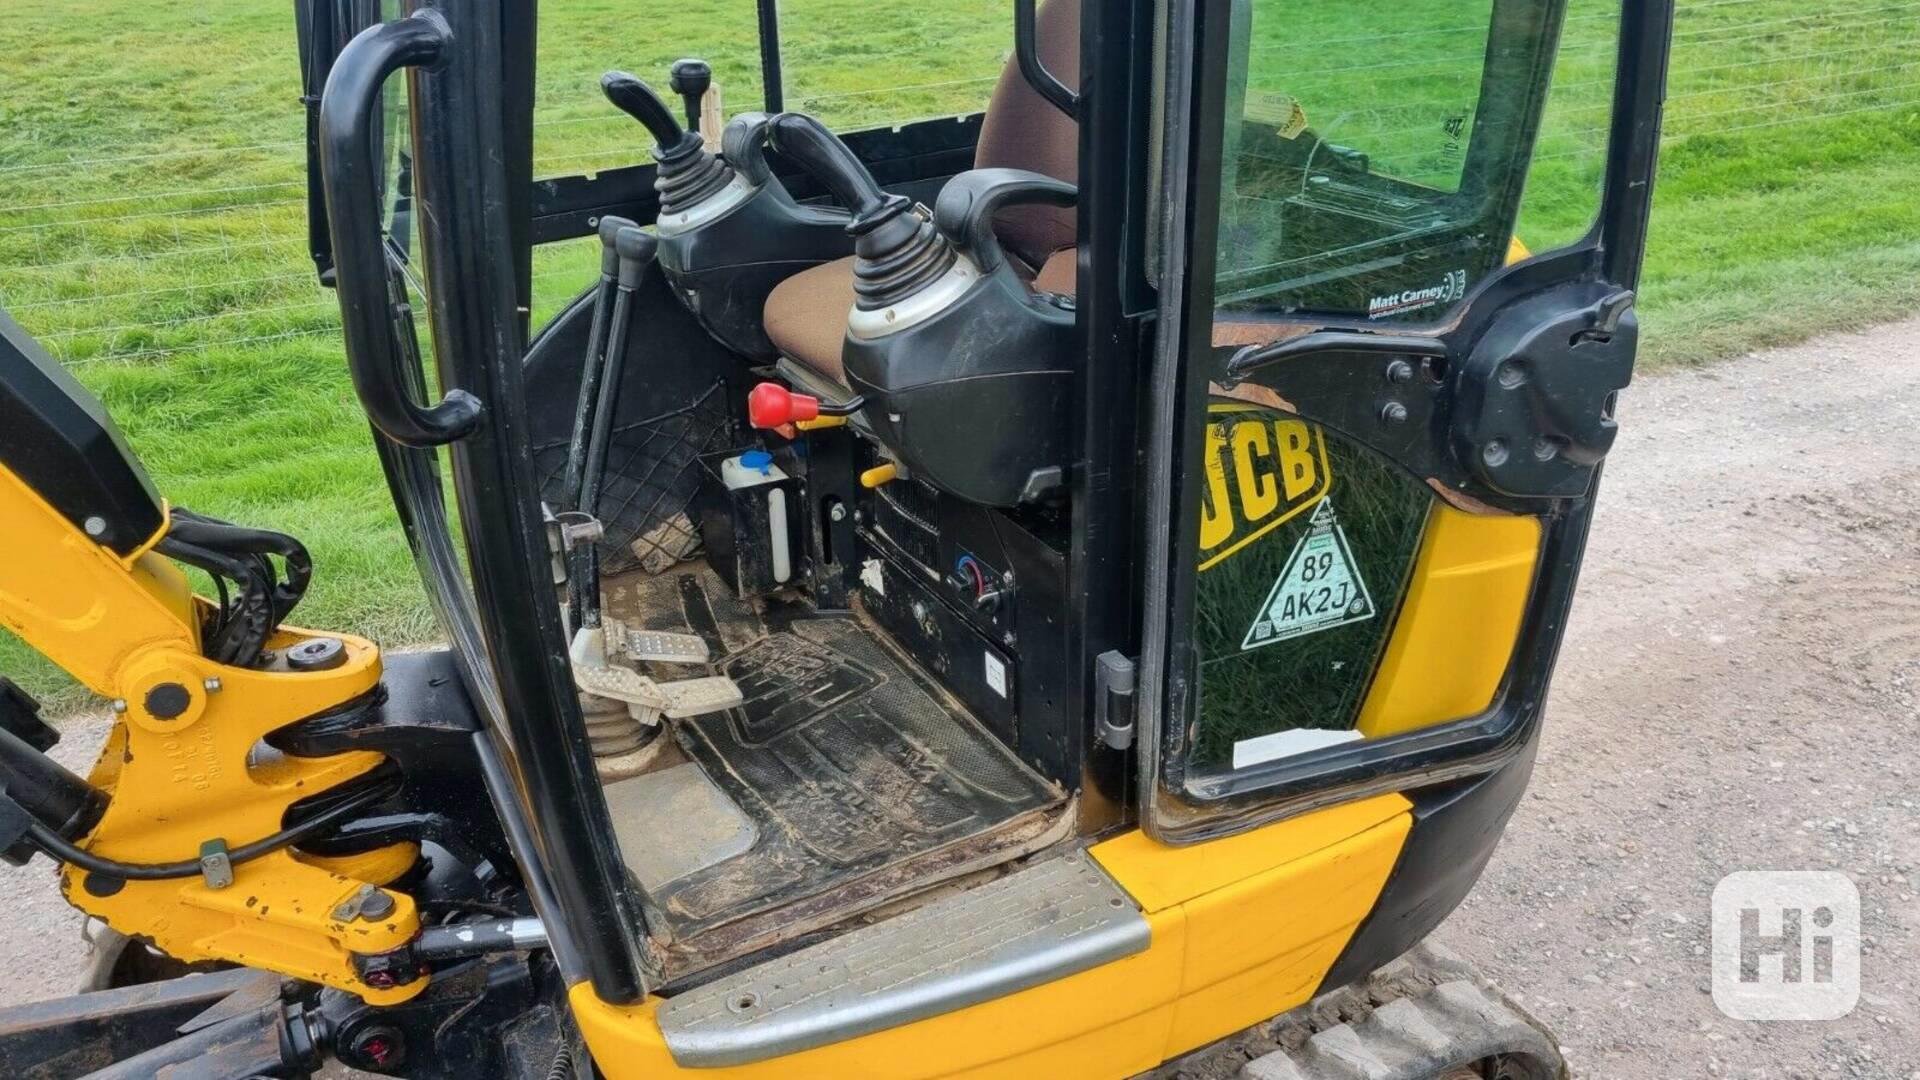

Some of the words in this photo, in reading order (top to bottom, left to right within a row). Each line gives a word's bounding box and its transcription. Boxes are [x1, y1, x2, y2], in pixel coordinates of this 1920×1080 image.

[1369, 295, 1399, 309] Matt
[1401, 286, 1443, 302] Carney
[1199, 420, 1316, 550] JCB
[1302, 552, 1333, 582] 89
[1281, 582, 1349, 621] AK2J
